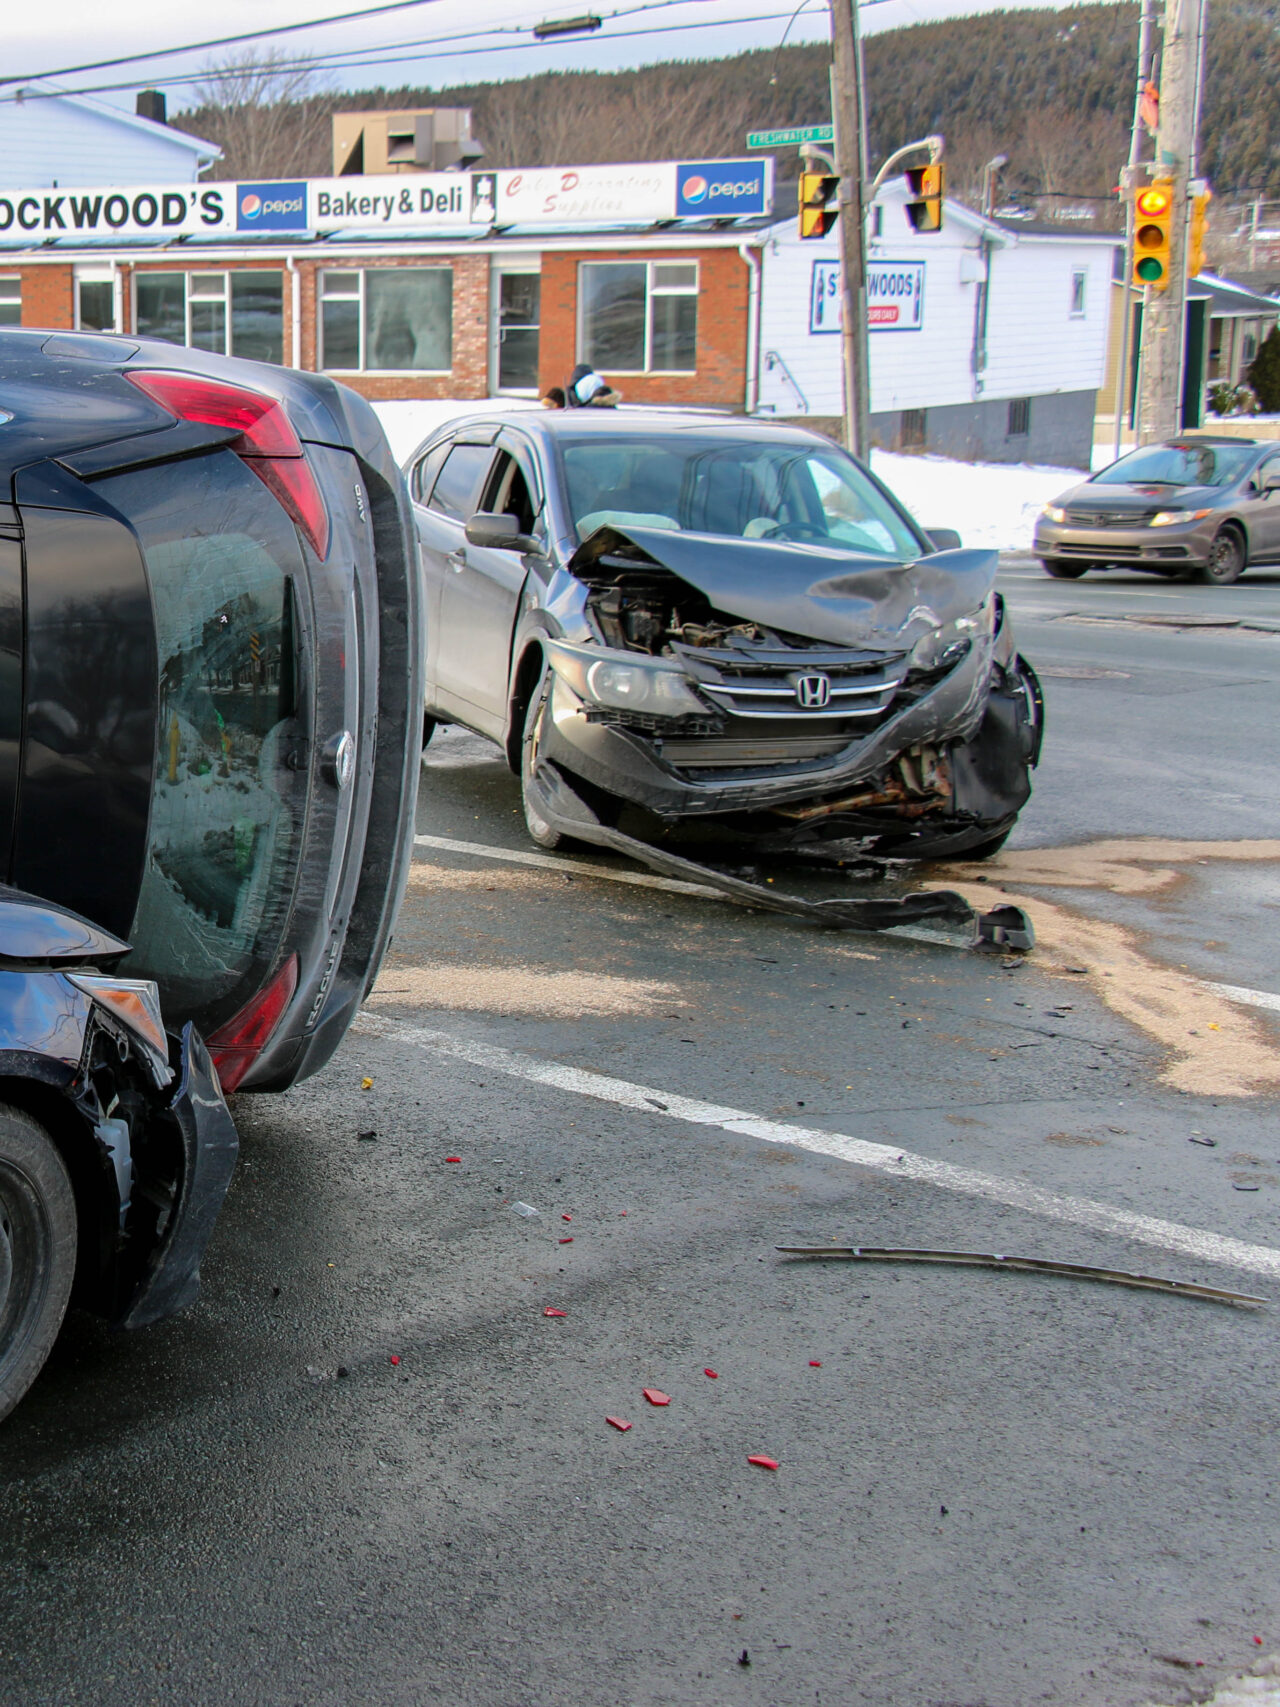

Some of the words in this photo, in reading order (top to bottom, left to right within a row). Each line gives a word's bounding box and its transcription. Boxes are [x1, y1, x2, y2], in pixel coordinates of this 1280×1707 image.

[708, 178, 760, 199] pepsi
[262, 196, 303, 215] pepsi
[318, 191, 395, 222] Bakery
[399, 188, 415, 214] &
[420, 186, 463, 213] Deli
[827, 273, 913, 297] SWOODS
[354, 483, 367, 523] AWD
[304, 940, 339, 1028] ROGUE
